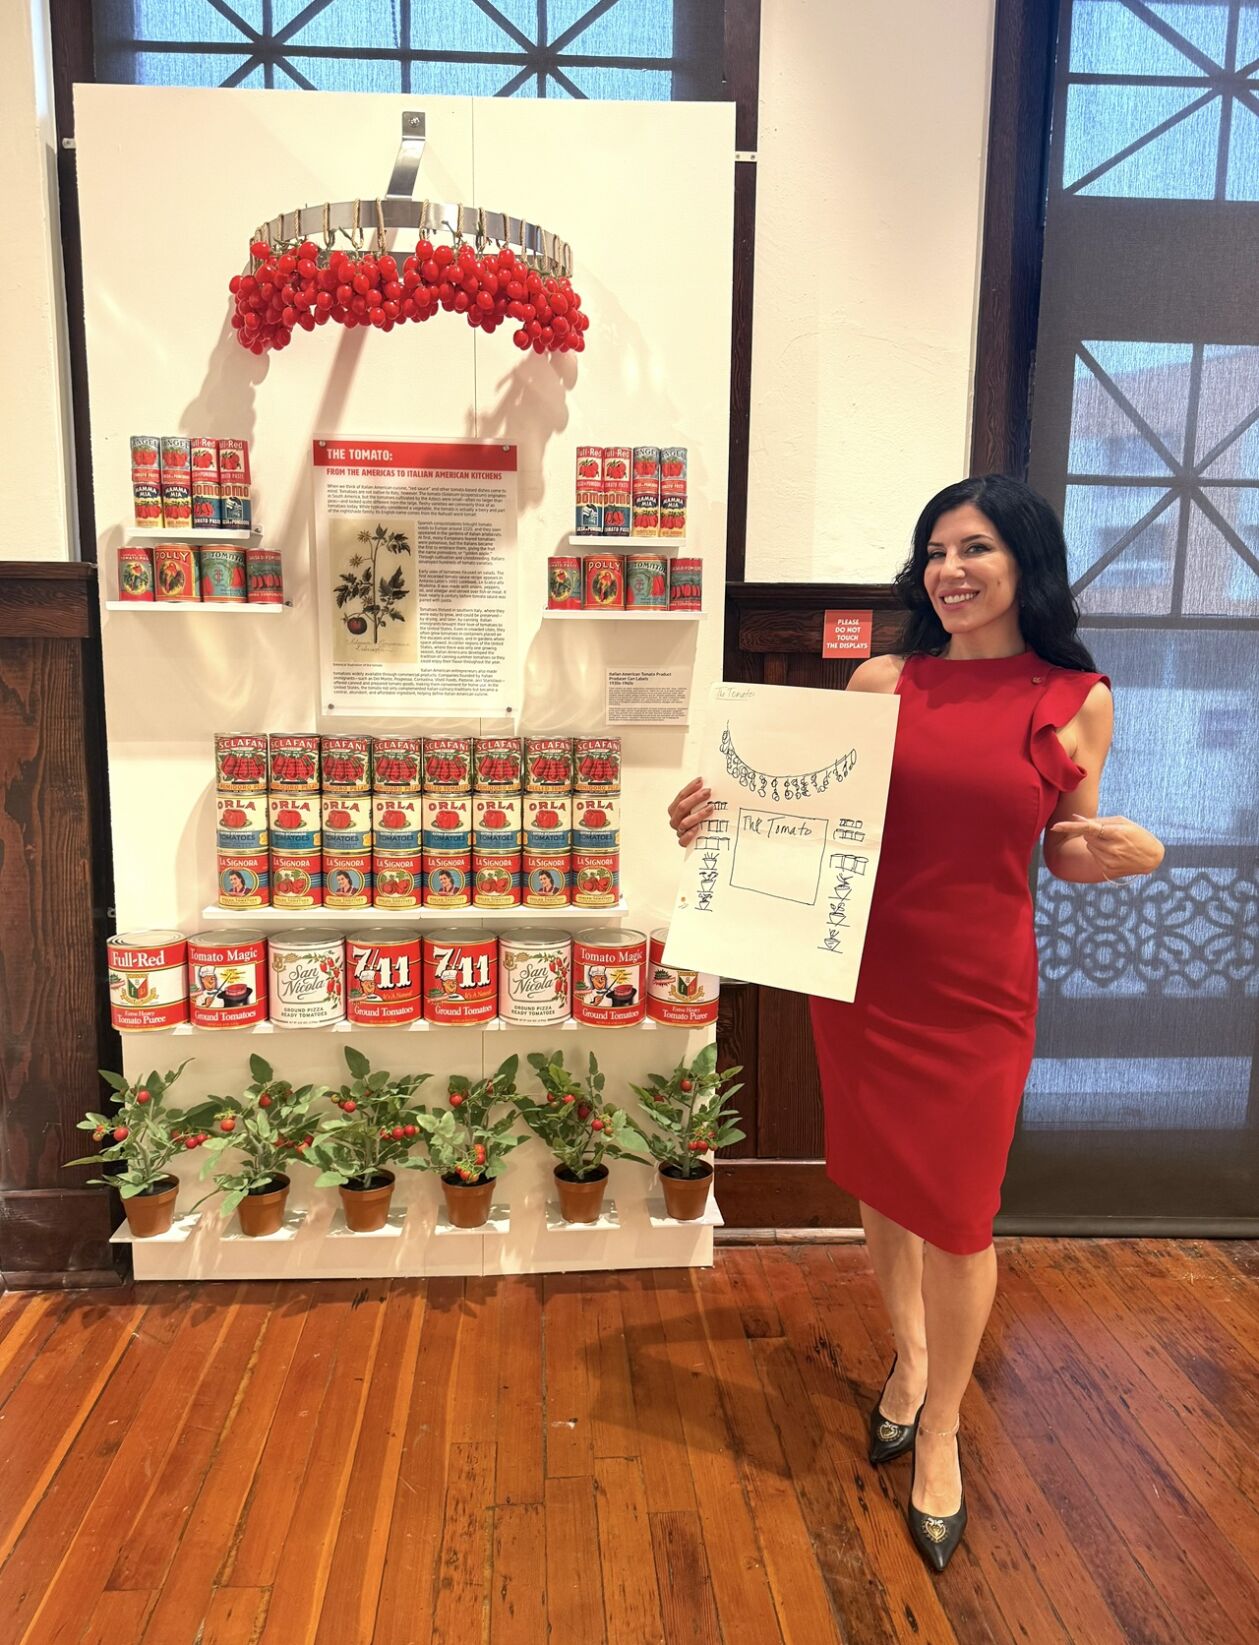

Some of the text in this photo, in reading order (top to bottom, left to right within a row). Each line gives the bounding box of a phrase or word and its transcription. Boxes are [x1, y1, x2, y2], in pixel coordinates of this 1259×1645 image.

[326, 448, 393, 461] THE TOMATO:
[326, 468, 345, 476] FROM
[471, 472, 502, 480] KITCHENS
[589, 561, 620, 571] POLLY
[376, 801, 415, 812] ORLA
[428, 802, 467, 812] ORLA
[477, 802, 514, 812] ORLA
[529, 801, 566, 812] ORLA
[577, 801, 614, 811] ORLA
[744, 815, 812, 838] The Tomato
[227, 858, 258, 867] SIGNORA
[280, 858, 310, 867] SIGNORA
[334, 859, 364, 867] SIGNORA
[384, 859, 413, 868] SIGNORA
[436, 858, 464, 866] SIGNORA
[482, 858, 512, 867] SIGNORA
[536, 858, 565, 867] SIGNORA
[584, 857, 613, 866] SIGNORA
[112, 950, 165, 967] Full-Red
[190, 948, 258, 962] Tomato Magic
[580, 948, 643, 964] Tomato Magic
[289, 964, 319, 980] San
[352, 946, 412, 989] 7/11
[433, 946, 490, 988] 7/11
[520, 964, 548, 980] San
[281, 977, 324, 997] Nicola
[512, 976, 554, 996] Nicola
[195, 1010, 256, 1021] Ground Tomatoes
[354, 1006, 414, 1016] Ground Tomatoes
[435, 1005, 492, 1016] Ground Tomatoes
[582, 1010, 640, 1020] Ground Tomatoes
[663, 1010, 688, 1020] Tomato
[117, 1015, 142, 1024] Tomato
